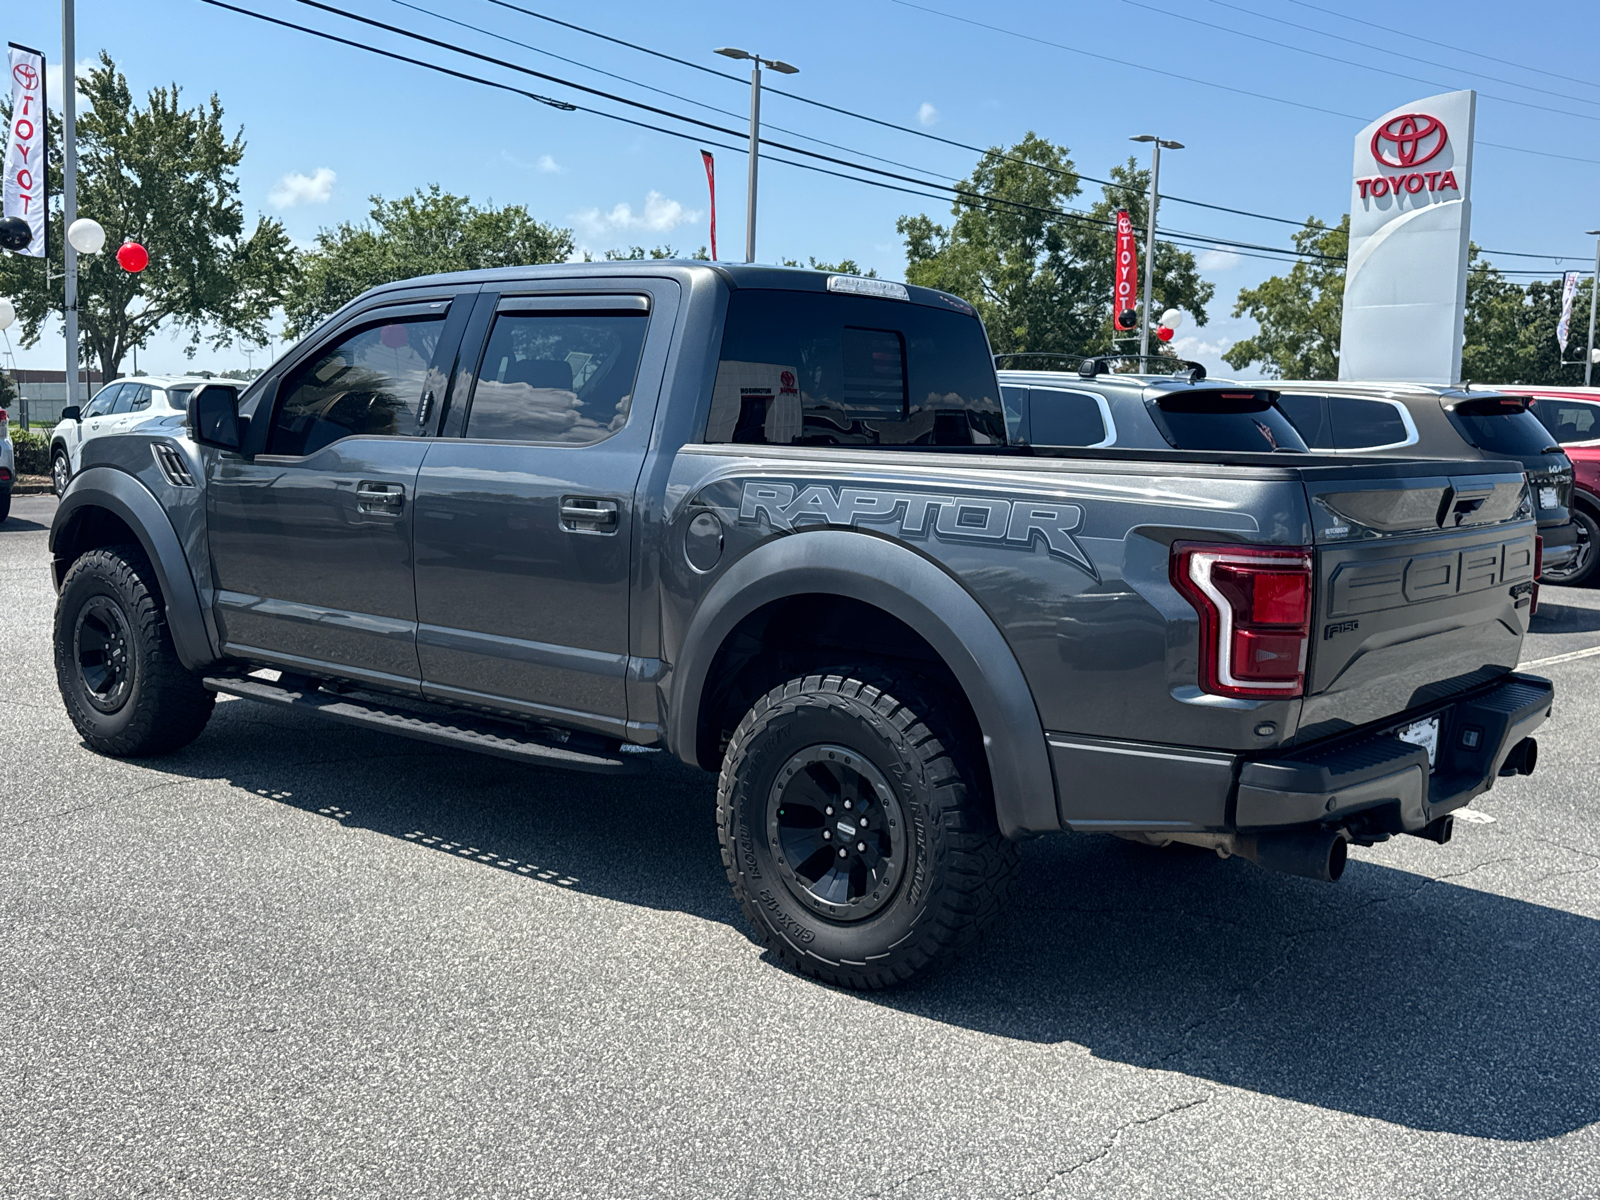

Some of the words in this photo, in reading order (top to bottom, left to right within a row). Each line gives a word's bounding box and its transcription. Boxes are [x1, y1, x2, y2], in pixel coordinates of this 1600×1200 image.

[15, 96, 33, 215] TOYOT
[1356, 170, 1458, 199] TOYOTA
[1119, 236, 1131, 310] TOYOT
[1548, 465, 1562, 473] KIA
[738, 480, 1102, 586] RAPTOR
[1328, 536, 1534, 619] FORD
